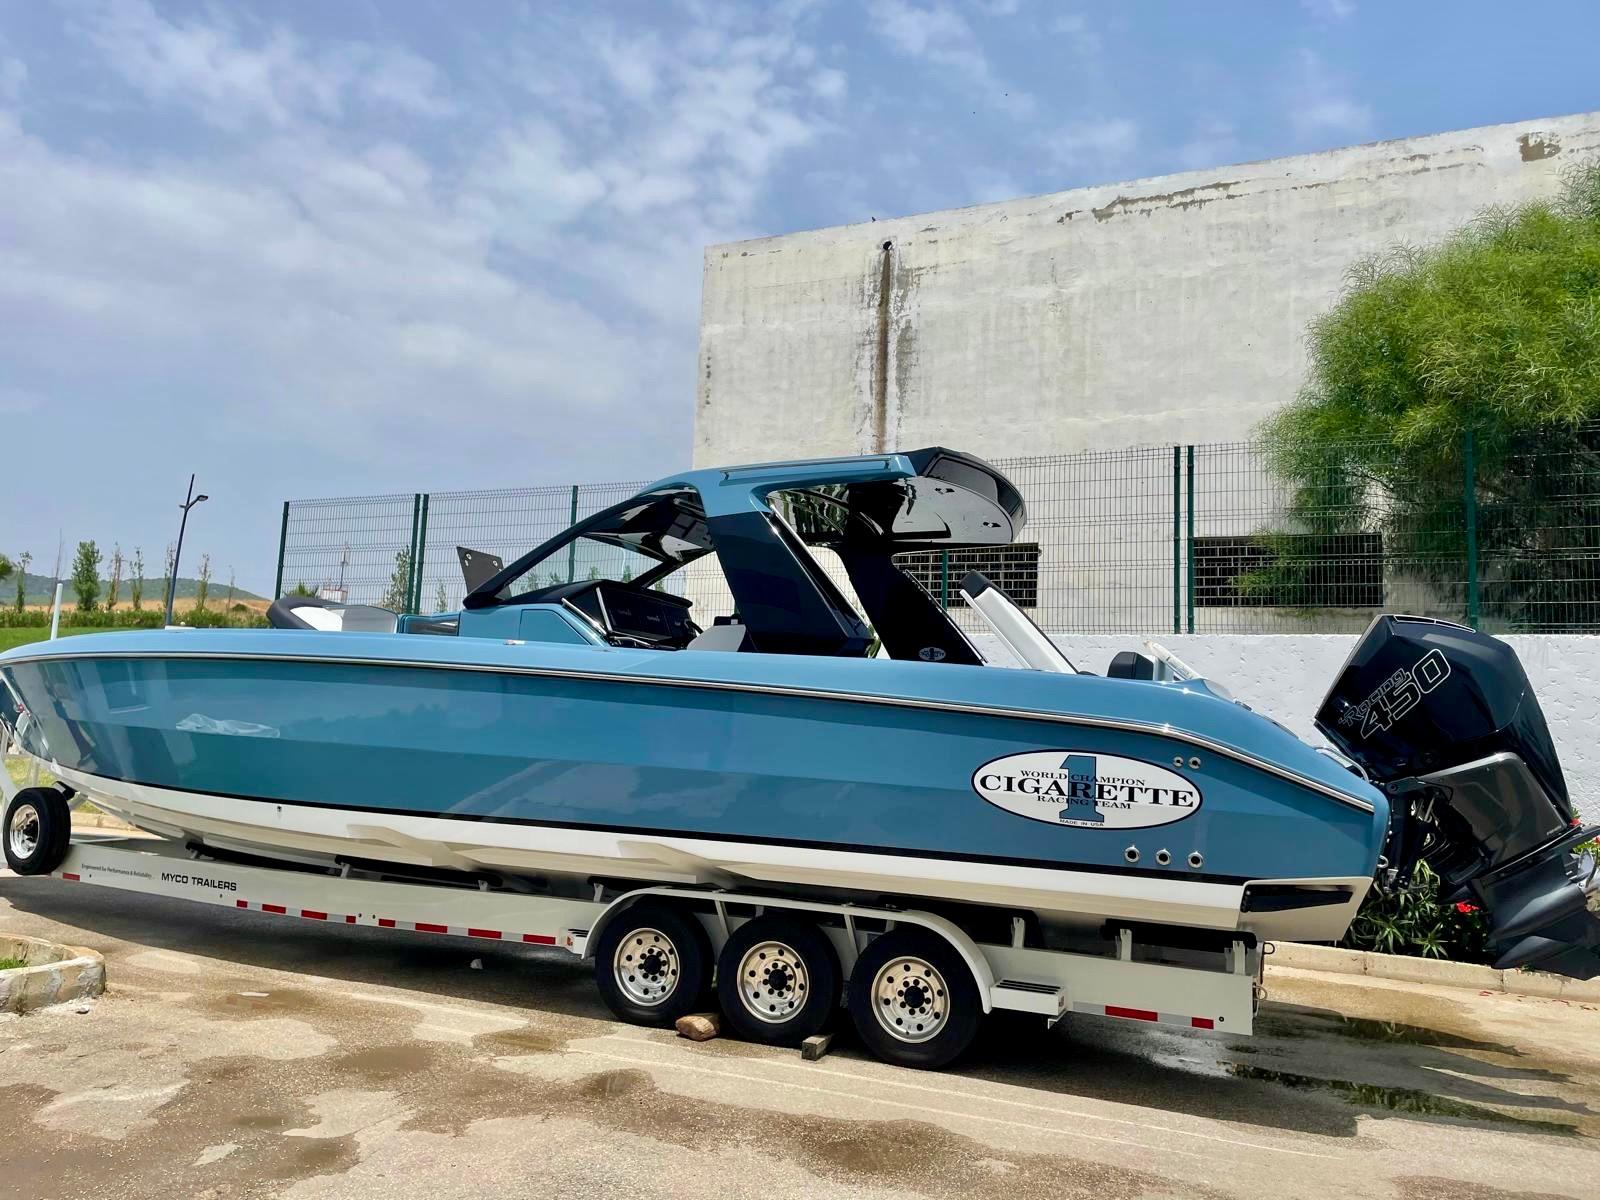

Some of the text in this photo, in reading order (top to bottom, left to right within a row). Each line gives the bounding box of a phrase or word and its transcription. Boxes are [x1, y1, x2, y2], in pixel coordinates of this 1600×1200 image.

[1339, 668, 1407, 727] Racing
[1360, 648, 1451, 739] 450
[979, 774, 1194, 807] CIGARETTE
[1020, 770, 1146, 786] WORLD CHAMPION
[1059, 754, 1105, 822] 1
[1037, 795, 1132, 810] RACING TEAM
[161, 872, 237, 891] MYCO TRAILERS
